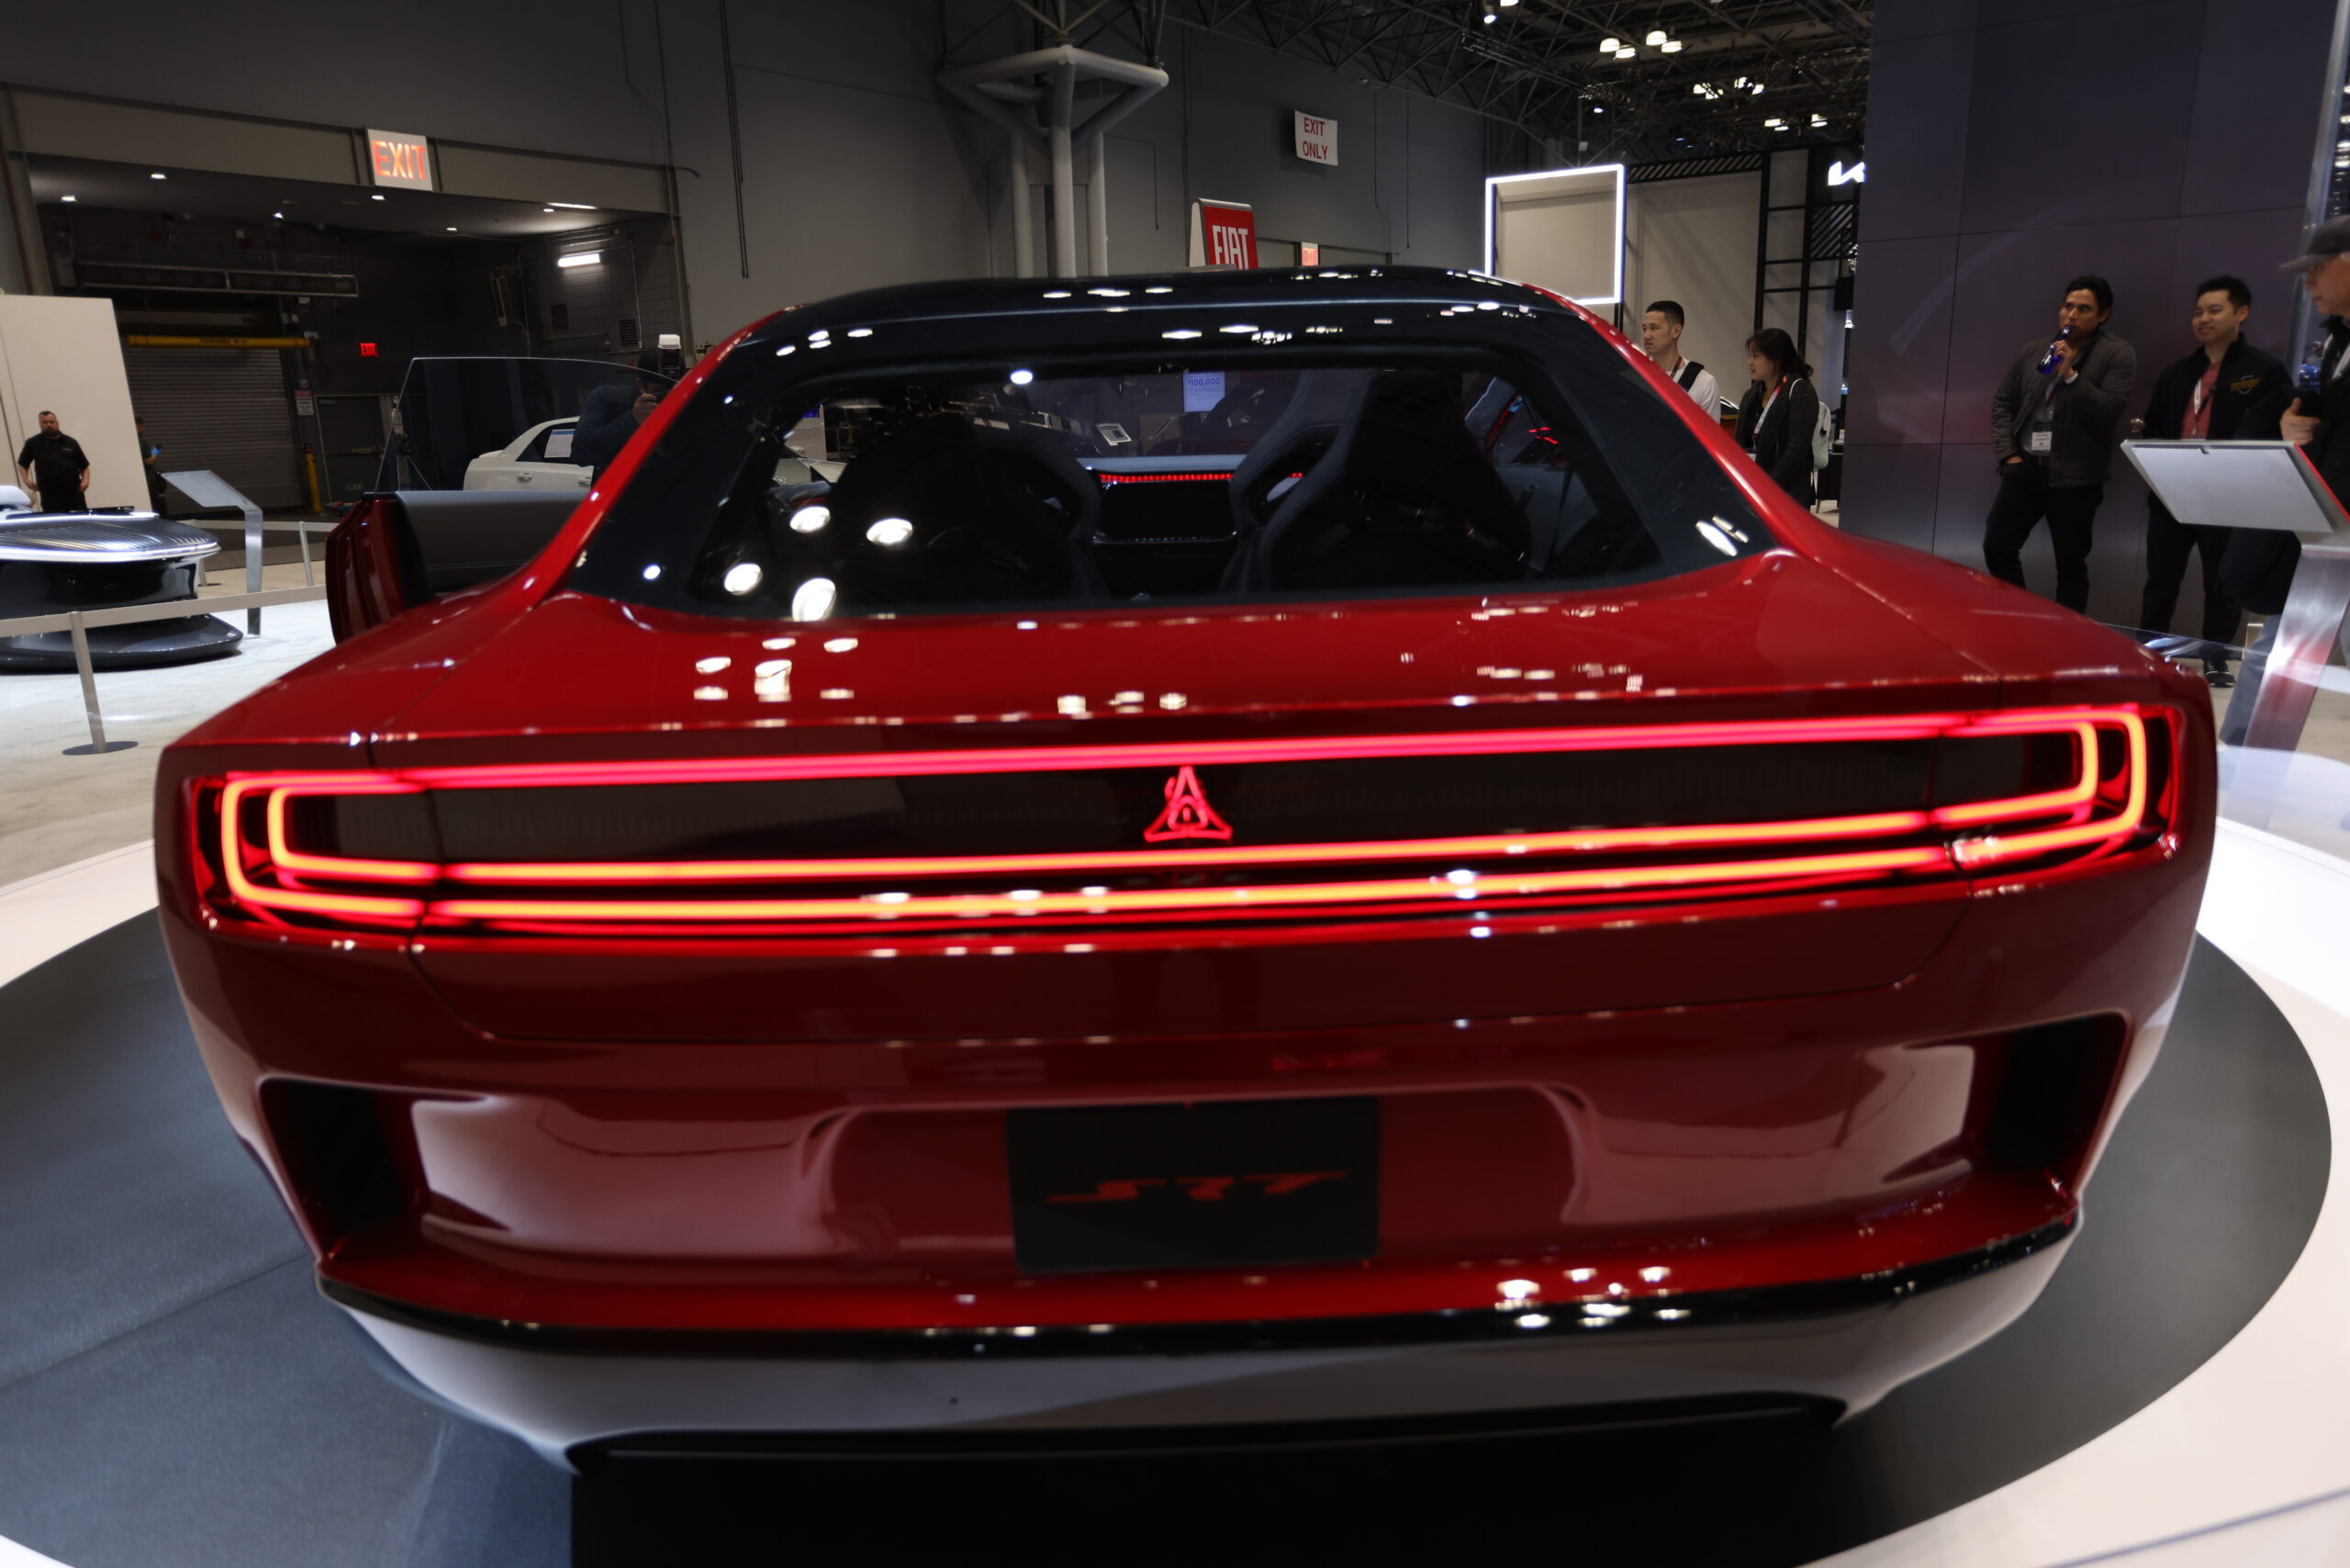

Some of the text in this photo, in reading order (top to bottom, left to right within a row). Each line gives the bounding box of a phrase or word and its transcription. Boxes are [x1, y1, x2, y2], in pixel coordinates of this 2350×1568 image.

[1304, 117, 1326, 137] EXIT
[371, 140, 427, 181] EXIT
[1302, 140, 1328, 161] ONLY
[1212, 224, 1248, 270] FIAT
